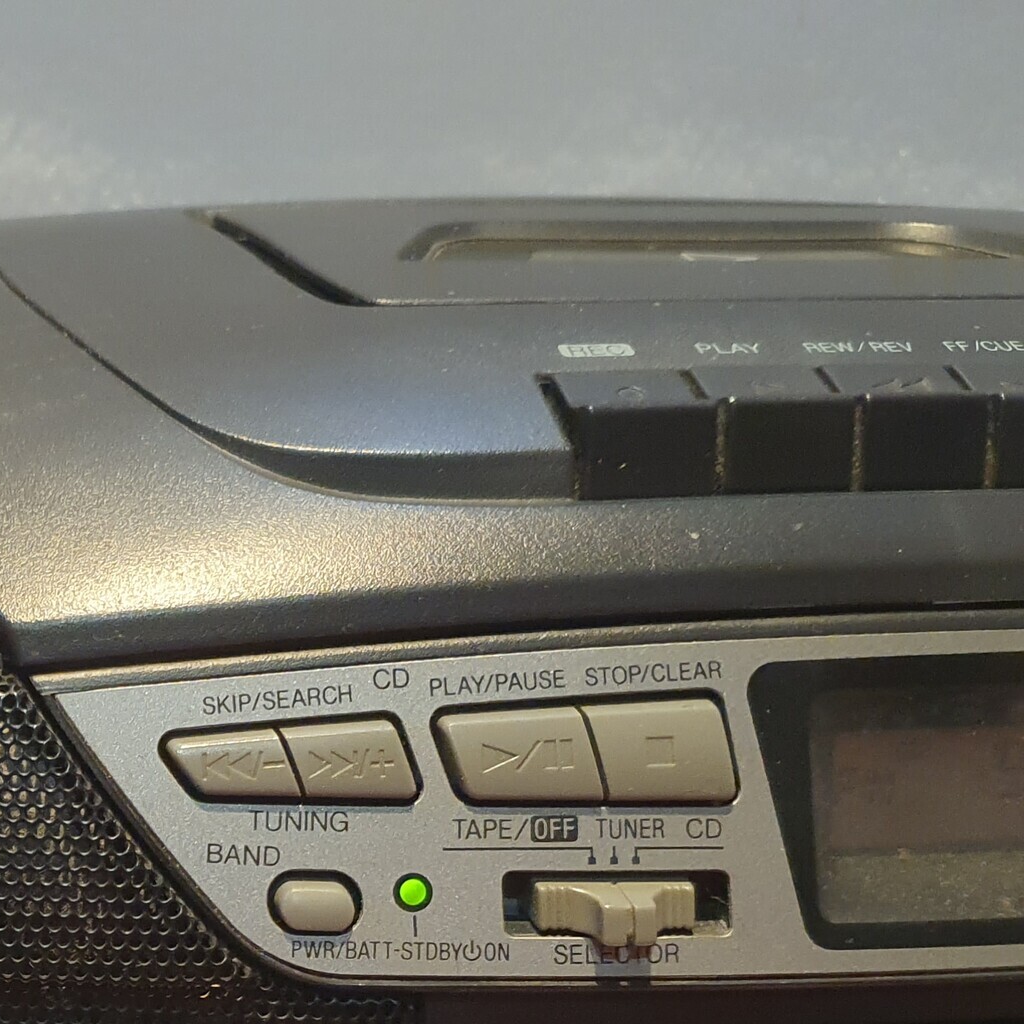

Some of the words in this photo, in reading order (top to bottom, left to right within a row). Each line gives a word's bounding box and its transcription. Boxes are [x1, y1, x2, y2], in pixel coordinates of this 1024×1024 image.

[694, 342, 760, 354] PLAY
[373, 669, 410, 690] CD
[429, 669, 566, 698] PLAY/PAUSE
[584, 660, 722, 687] STOP/CLEAR
[202, 684, 353, 716] SKIP/SEARCH
[250, 810, 350, 833] TUNING
[596, 818, 665, 839] TUNER
[686, 819, 723, 839] CD
[206, 844, 281, 867] BAND
[553, 944, 680, 966] SELECTOR
